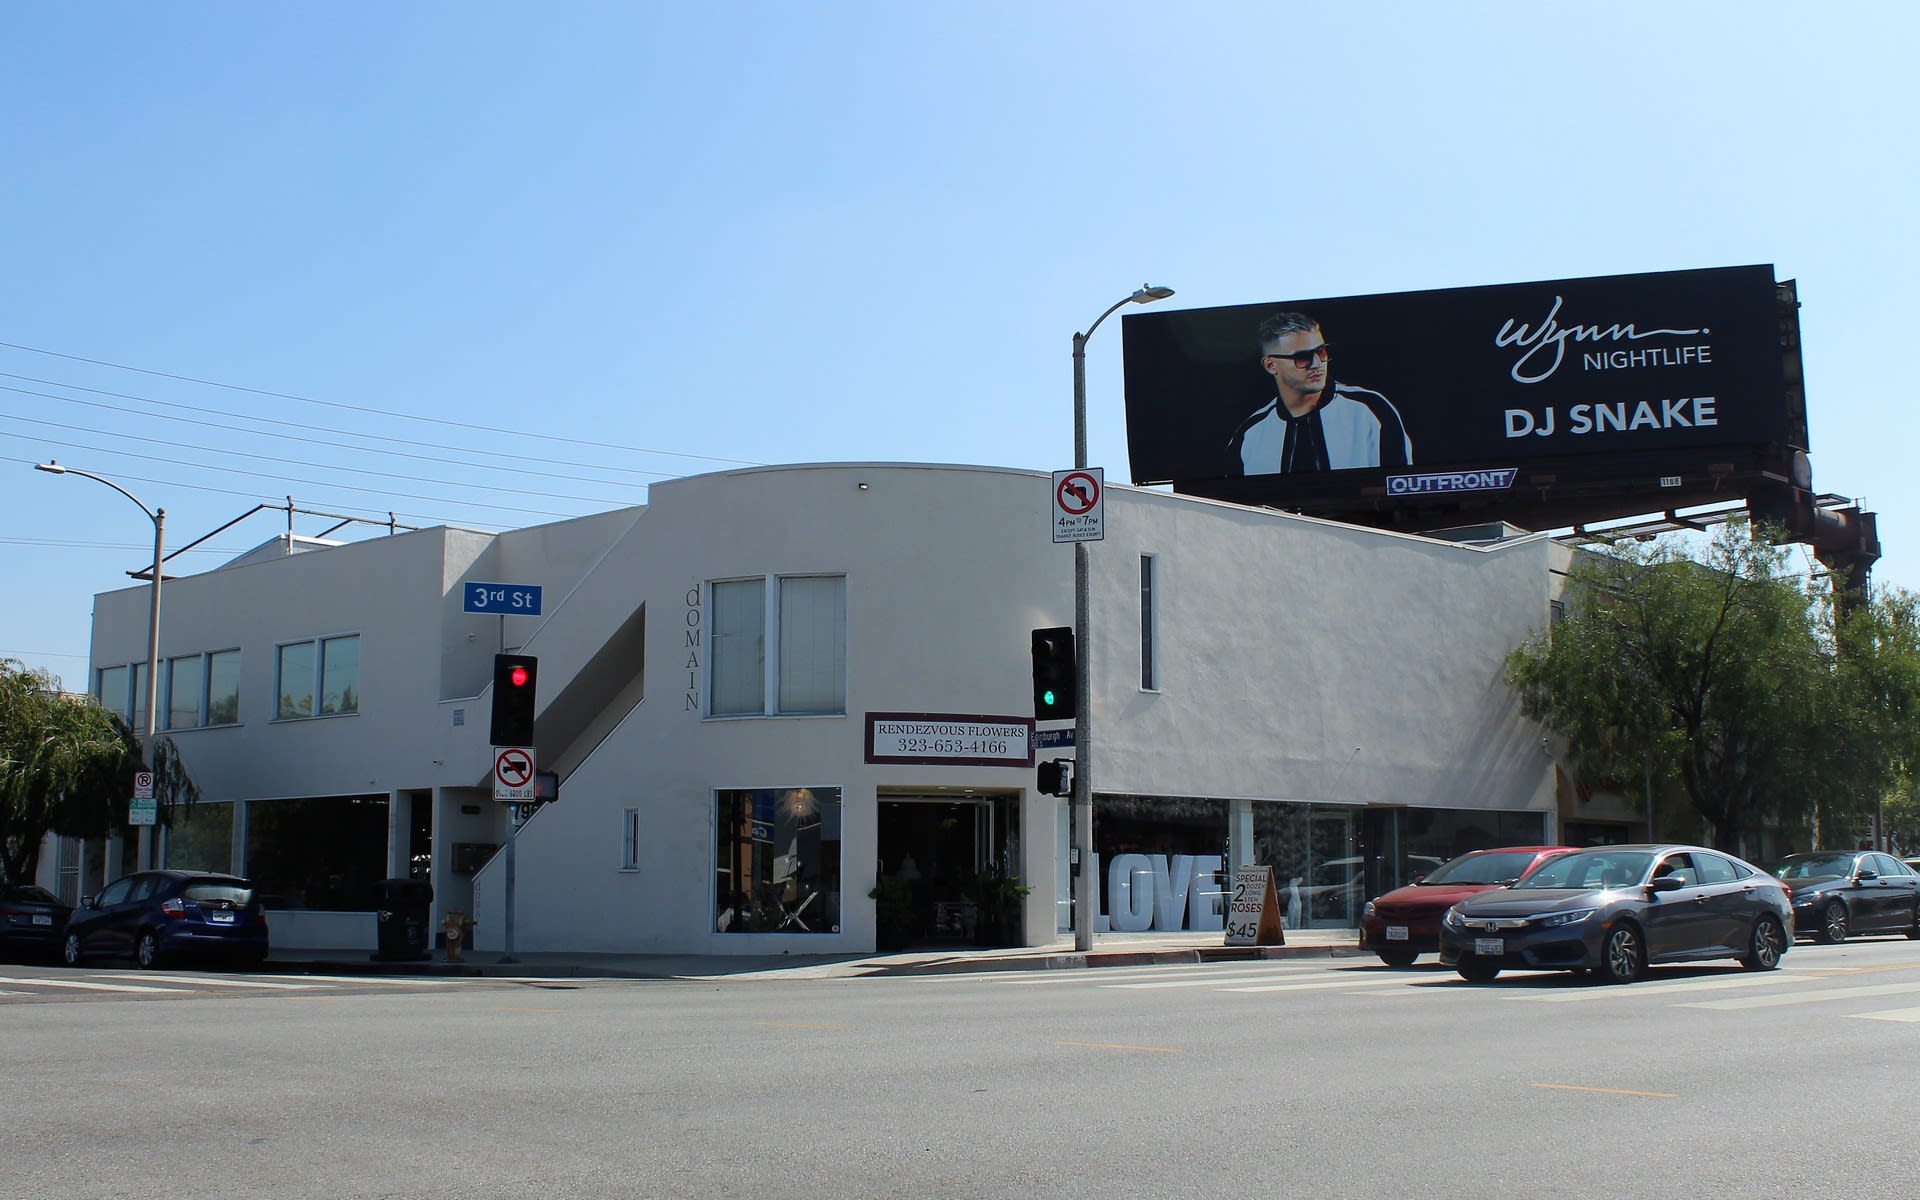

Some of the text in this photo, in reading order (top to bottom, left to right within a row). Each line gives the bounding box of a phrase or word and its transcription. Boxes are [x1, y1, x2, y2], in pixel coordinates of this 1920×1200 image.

[1584, 346, 1712, 371] NIGHTLIFE
[1504, 397, 1718, 438] DJ SNAKE
[1391, 471, 1510, 493] OUTFRONT
[473, 588, 533, 608] 3rd St
[879, 724, 1025, 738] RENDEZVOUS FLOWERS
[898, 738, 1007, 754] 323-653-4166
[1236, 874, 1267, 882] SPECIAL
[1091, 852, 1224, 932] LOVE
[1233, 883, 1246, 902] 2
[1231, 903, 1263, 912] ROSES
[1226, 920, 1257, 938] $45
